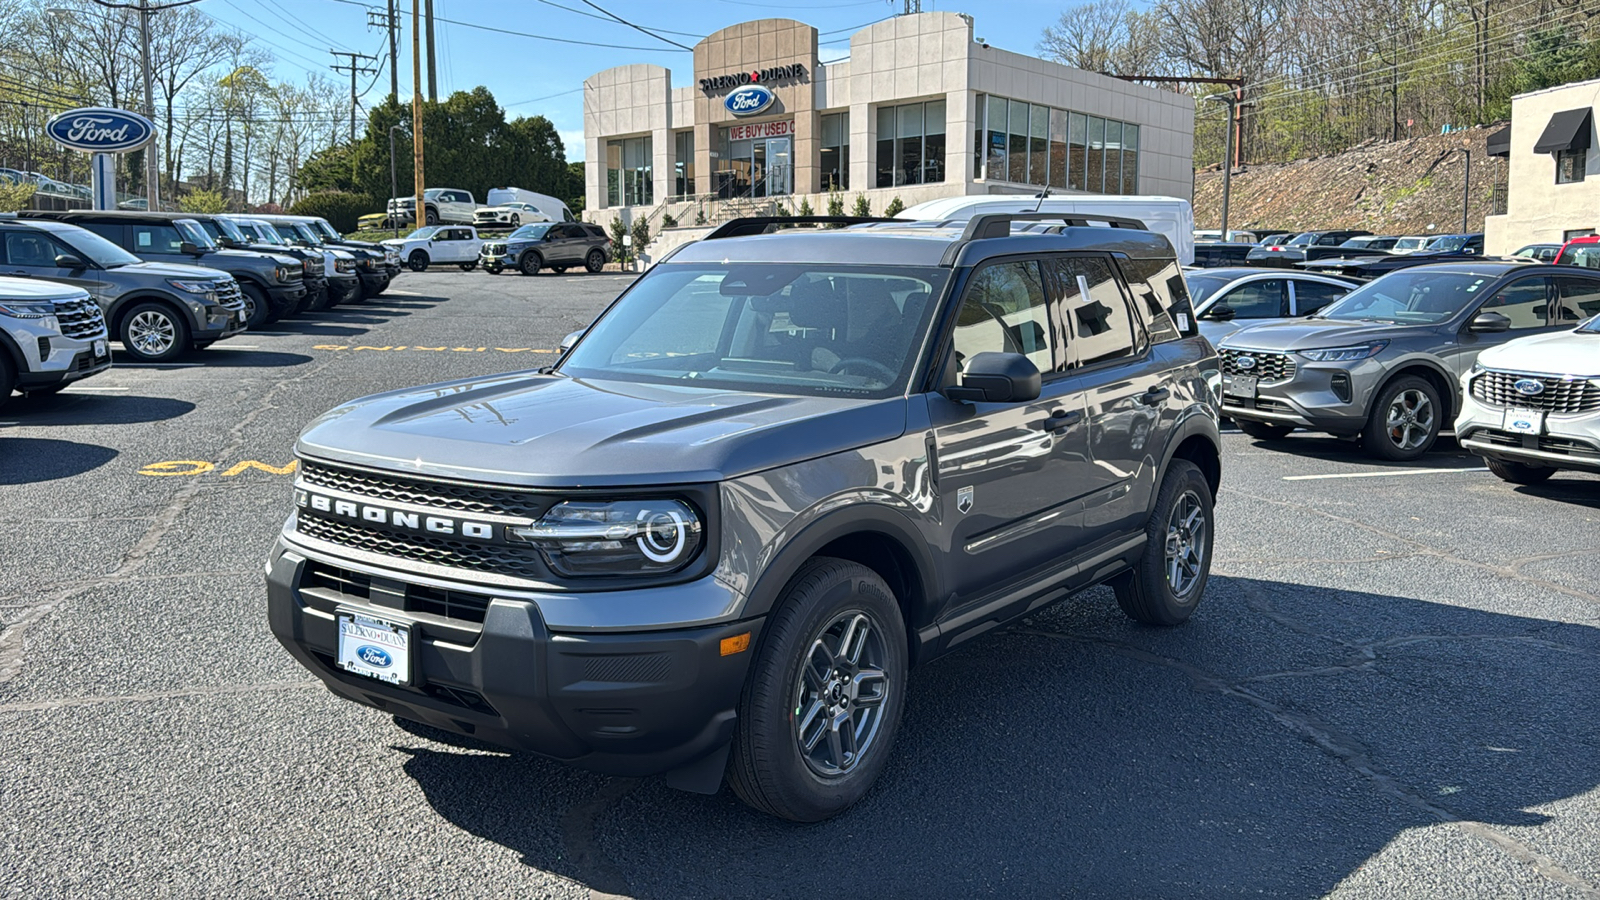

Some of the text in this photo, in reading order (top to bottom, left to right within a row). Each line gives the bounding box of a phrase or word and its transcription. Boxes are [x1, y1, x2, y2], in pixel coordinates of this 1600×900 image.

[699, 63, 803, 91] SALERNO DUANE
[732, 91, 760, 110] Ford
[67, 117, 130, 142] Ford
[730, 127, 745, 139] WE
[745, 124, 762, 138] BUY
[764, 122, 788, 136] USED
[311, 494, 493, 540] BRONCO
[341, 623, 406, 648] SALERNO DUANE
[363, 647, 387, 666] Ford
